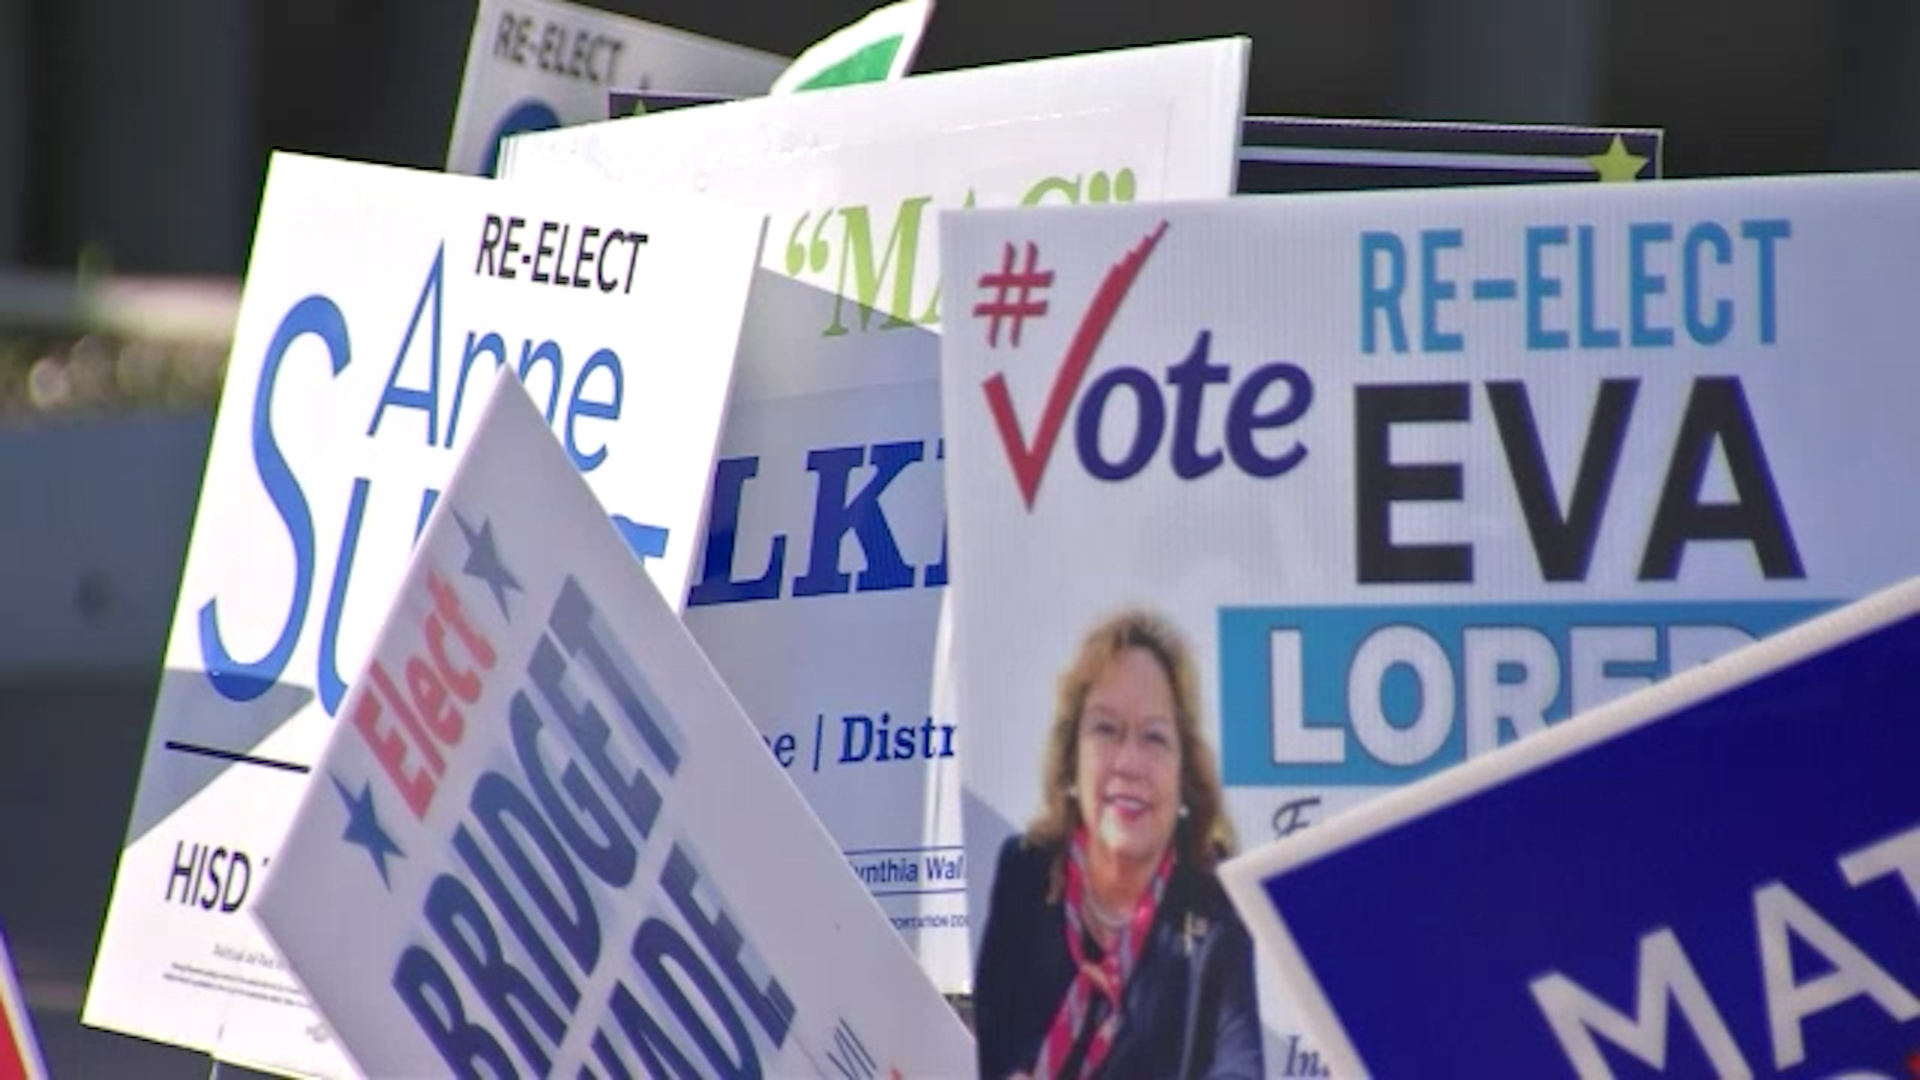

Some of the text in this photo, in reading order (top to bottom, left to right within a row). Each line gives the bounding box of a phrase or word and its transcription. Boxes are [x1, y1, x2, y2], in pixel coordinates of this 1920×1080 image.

[494, 12, 624, 84] RE-ELECT
[475, 213, 649, 295] RE-ELECT
[1358, 218, 1793, 355] RE-ELECT
[687, 436, 948, 608] LK
[1353, 374, 1808, 586] EVA
[353, 567, 499, 822] Elect
[164, 839, 252, 914] HISD
[391, 573, 683, 1080] BRIDGET
